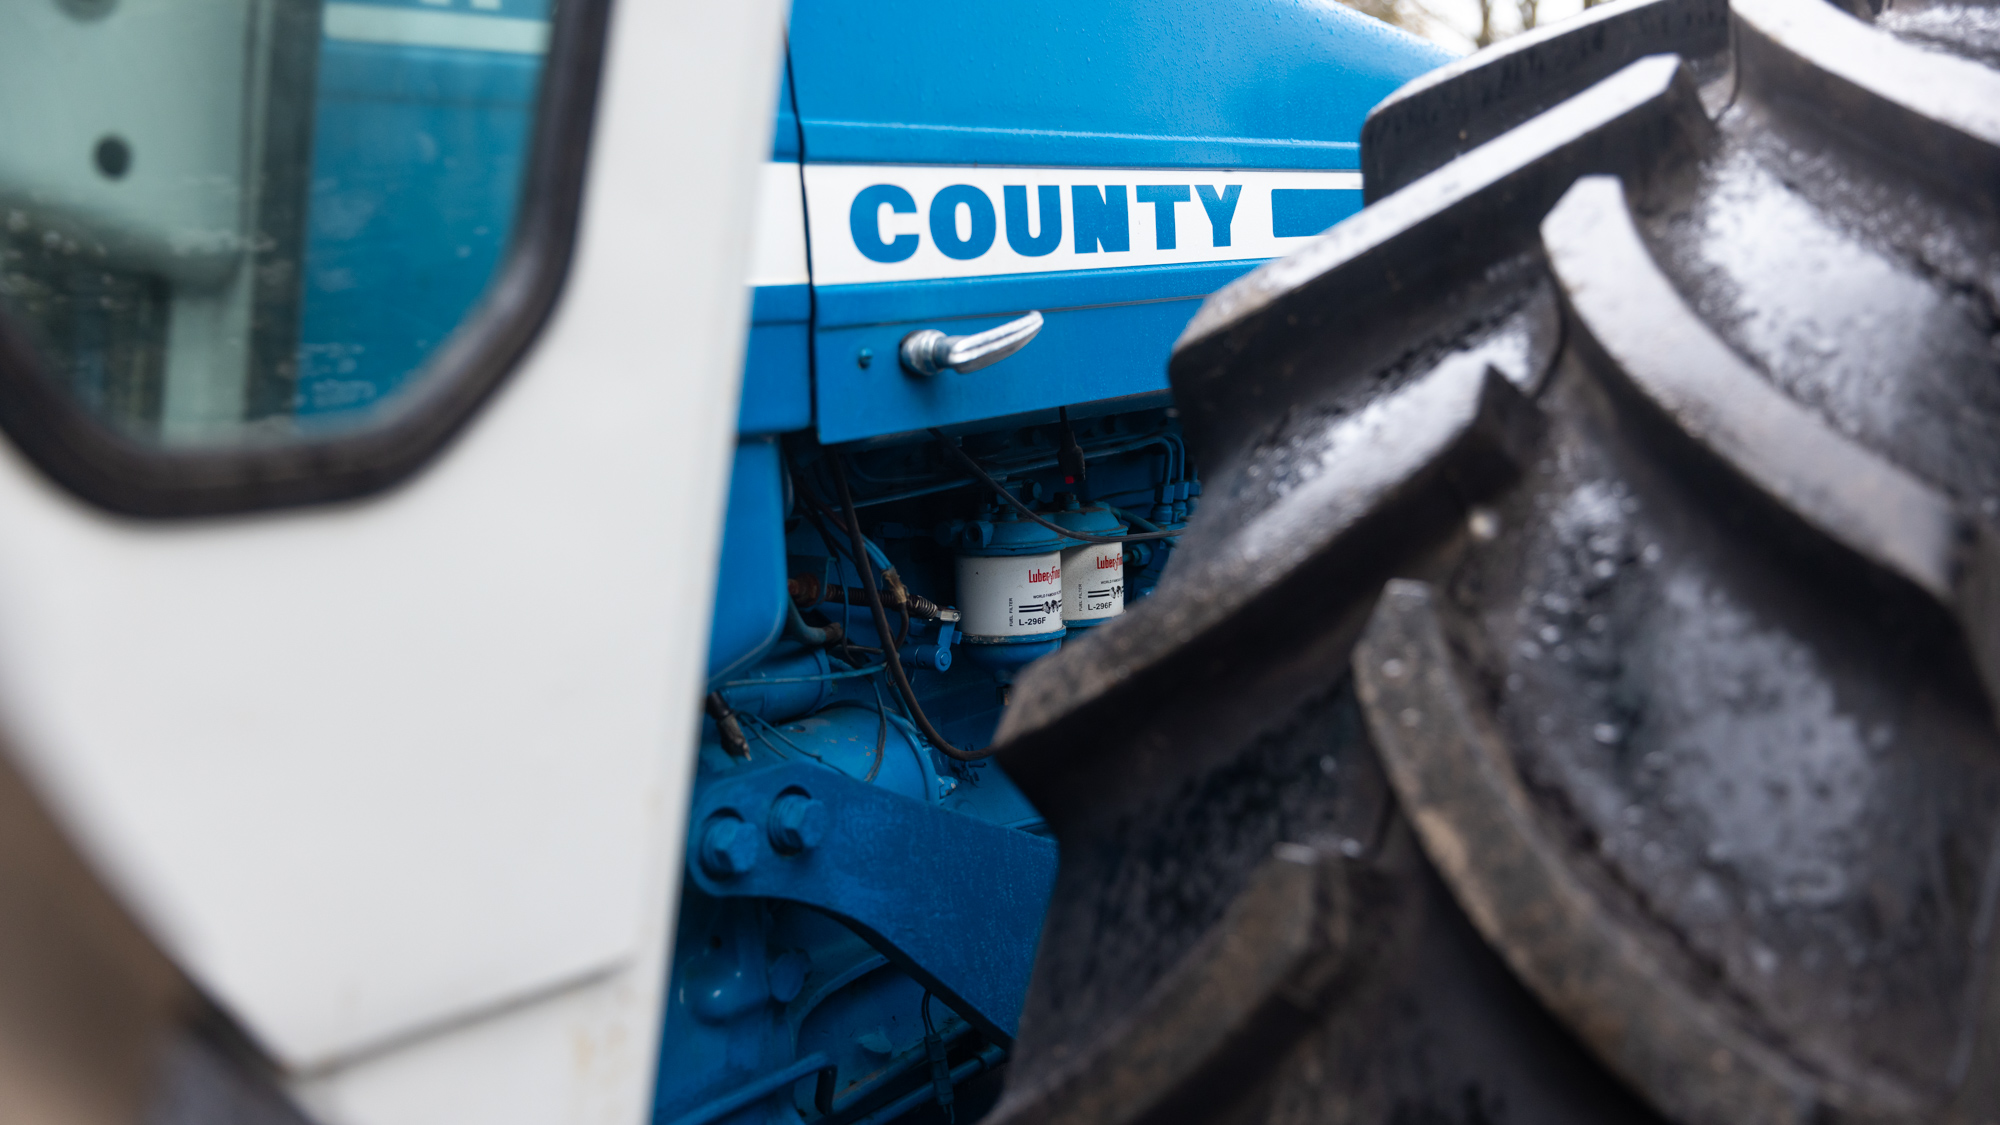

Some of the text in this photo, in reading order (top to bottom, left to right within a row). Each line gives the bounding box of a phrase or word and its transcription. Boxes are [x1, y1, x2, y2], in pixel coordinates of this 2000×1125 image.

[849, 183, 1243, 264] COUNTY
[1088, 601, 1112, 611] L-296F
[1019, 616, 1046, 626] L-296F
